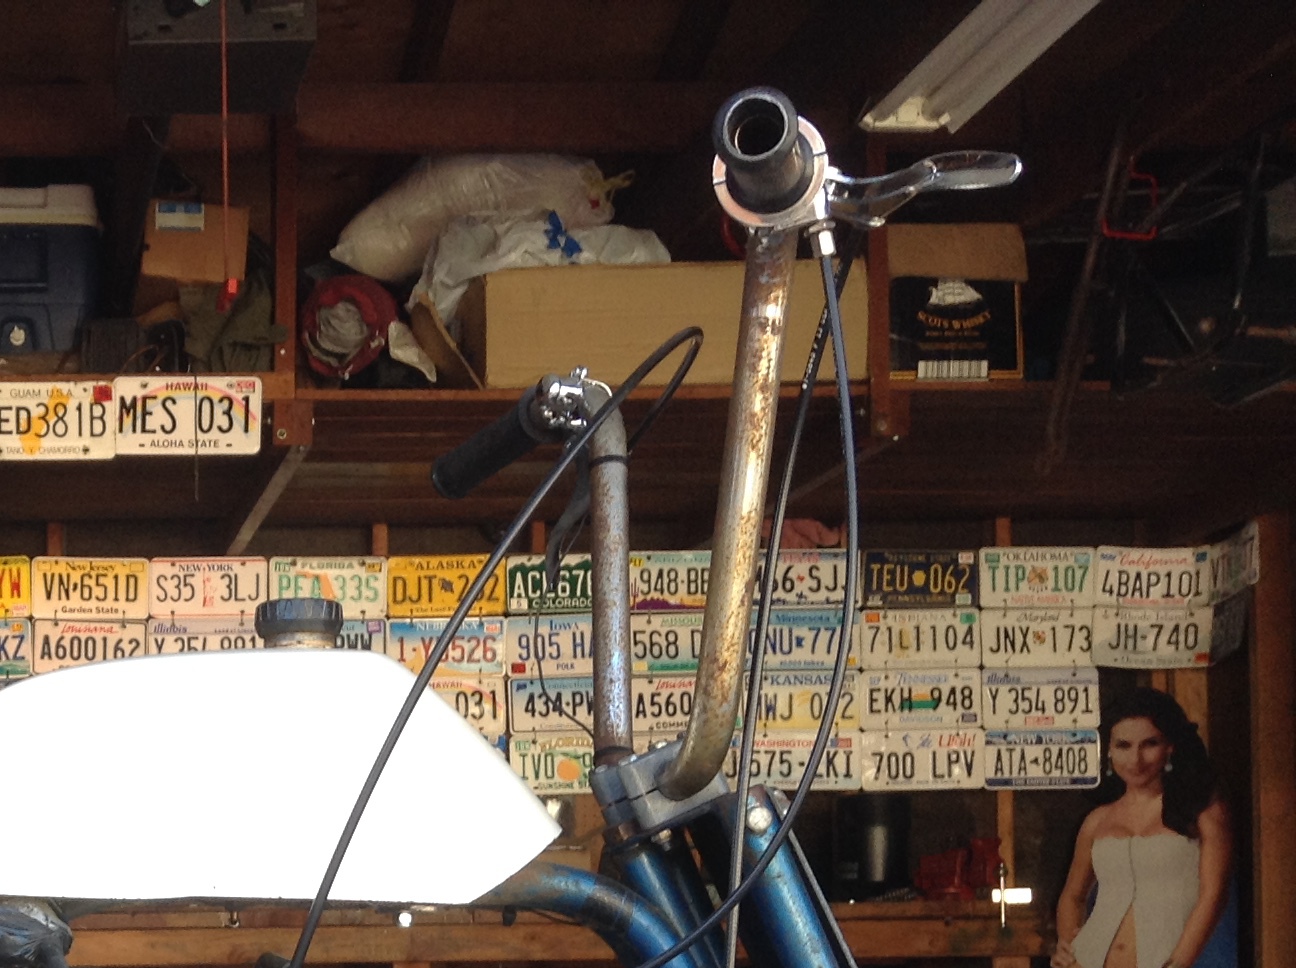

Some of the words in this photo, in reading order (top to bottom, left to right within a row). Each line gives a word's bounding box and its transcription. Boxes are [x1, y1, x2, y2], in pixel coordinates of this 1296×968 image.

[10, 388, 41, 398] GUAM
[165, 382, 208, 391] HAWAII
[118, 395, 177, 434] MES
[198, 395, 250, 434] 031
[150, 440, 185, 448] ALOHA
[188, 440, 220, 448] STATE
[1006, 552, 1070, 562] OKLAHOMA
[1119, 551, 1188, 570] California
[65, 561, 86, 572] New
[88, 561, 115, 574] Jersey
[178, 564, 201, 572] NEW
[206, 564, 234, 572] YORK
[300, 561, 354, 570] FLORIDA
[415, 562, 476, 571] ALASKA
[870, 563, 908, 593] TEU
[930, 563, 970, 594] 062
[988, 564, 1026, 593] TIP
[1052, 564, 1089, 593] 107
[1101, 569, 1203, 599] 4BAP101
[220, 573, 260, 602] 3LJ
[392, 574, 437, 604] DJT
[61, 606, 92, 614] Garden
[95, 606, 119, 614] State
[891, 613, 947, 622] INDIANA
[775, 613, 830, 624] Minnesota
[1016, 612, 1060, 625] Maryland
[518, 632, 561, 661] 905
[633, 630, 679, 659] 568
[989, 626, 1031, 653] JNX
[1050, 626, 1092, 653] 173
[556, 663, 575, 671] POLK
[896, 673, 949, 686] TENNESSEE
[868, 686, 913, 715] EKH
[930, 686, 974, 712] 948
[1008, 687, 1046, 715] 354
[1054, 686, 1093, 715] 891
[871, 752, 915, 780] 700
[932, 751, 975, 779] LPV
[994, 747, 1028, 776] ATA
[1042, 747, 1088, 776] 8408
